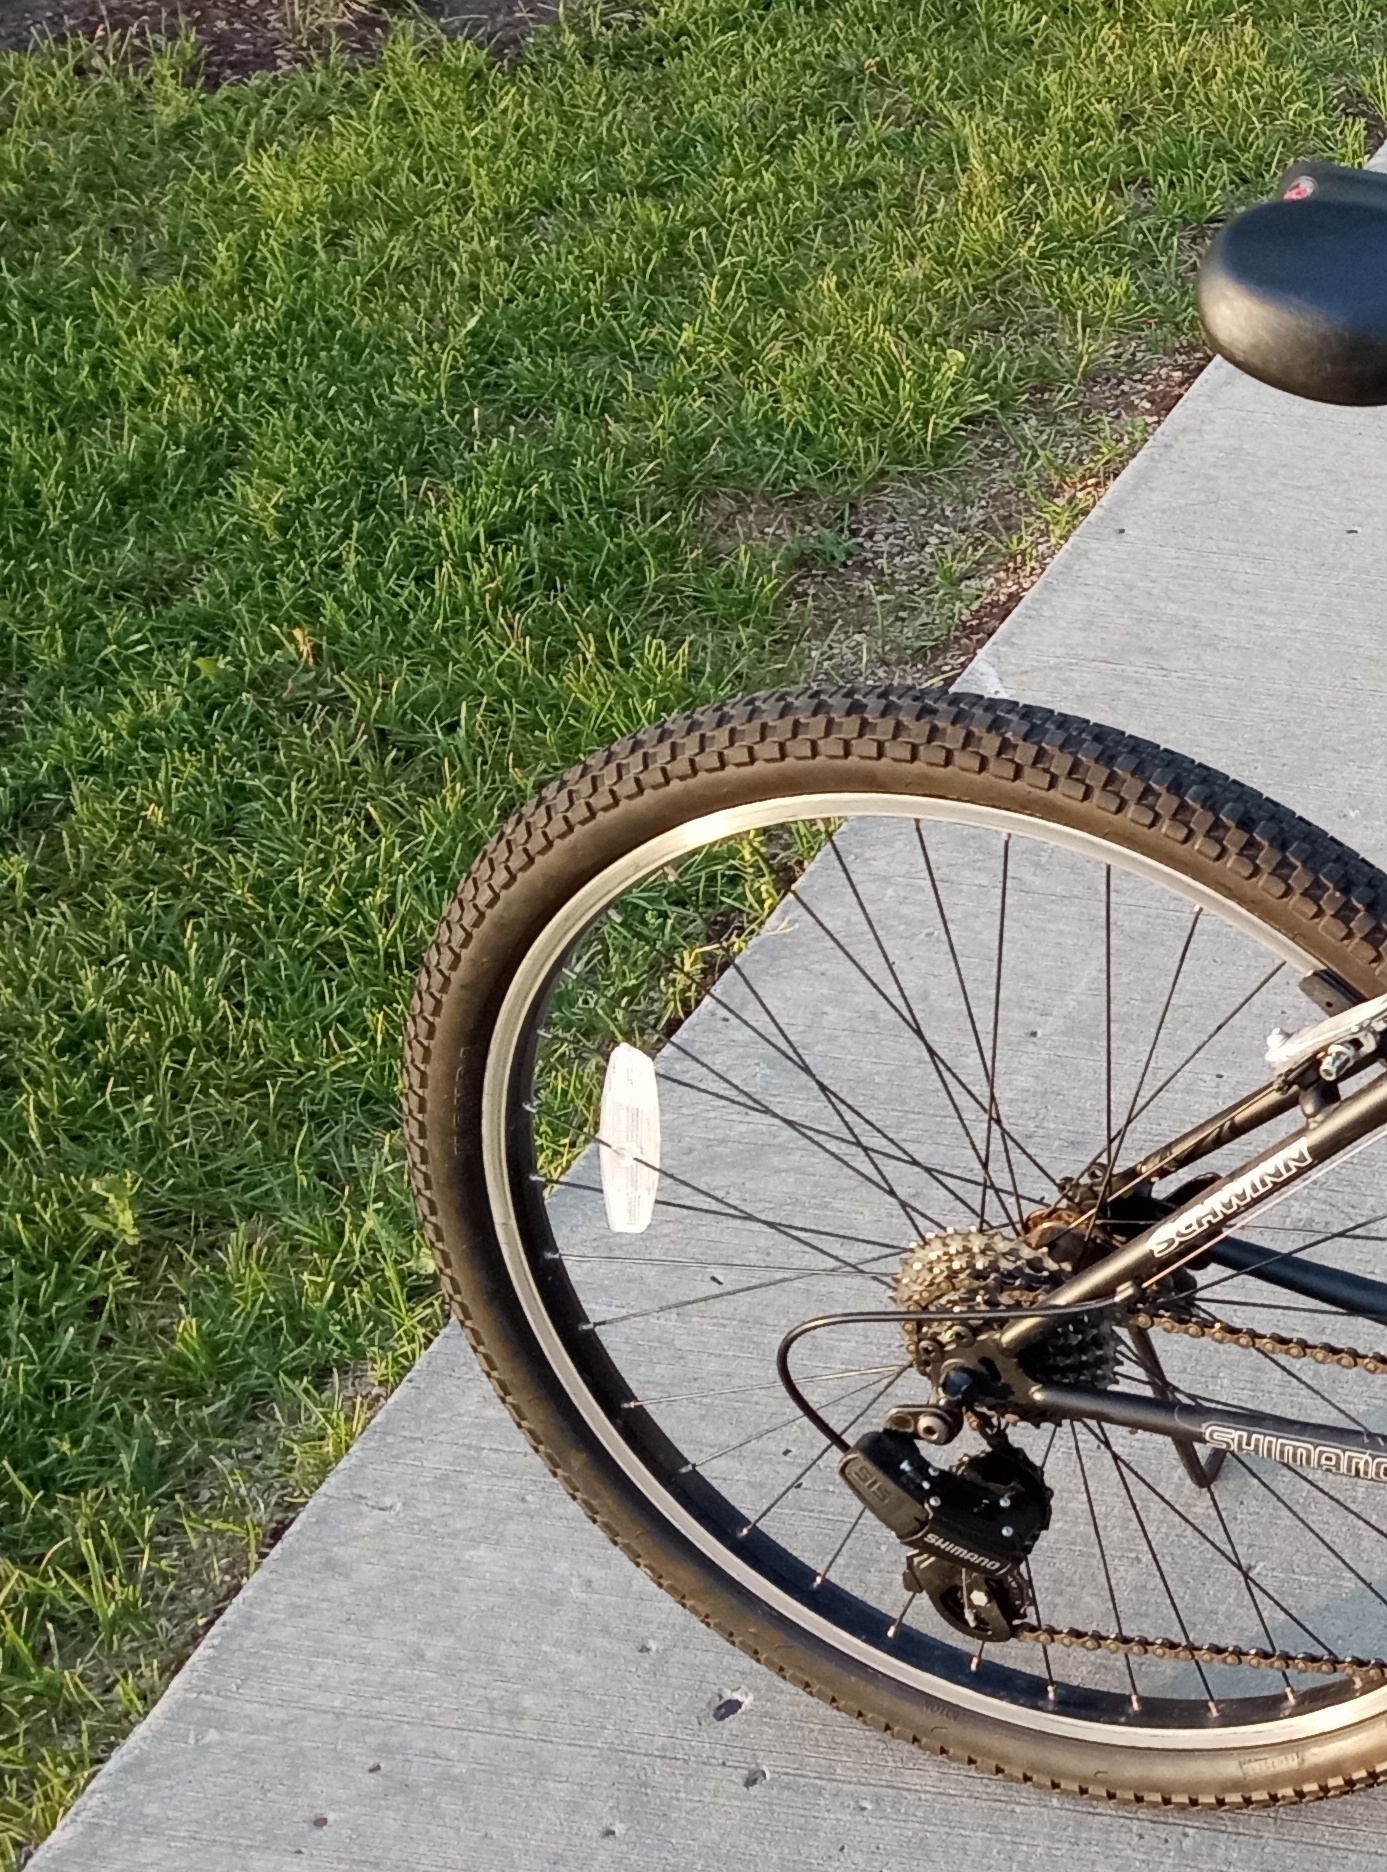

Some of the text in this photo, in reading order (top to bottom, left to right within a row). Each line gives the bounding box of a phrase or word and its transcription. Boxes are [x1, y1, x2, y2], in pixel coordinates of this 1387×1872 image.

[1147, 1137, 1314, 1259] SCHWINN
[853, 1465, 893, 1504] SIS
[923, 1532, 1001, 1572] SHIMANO
